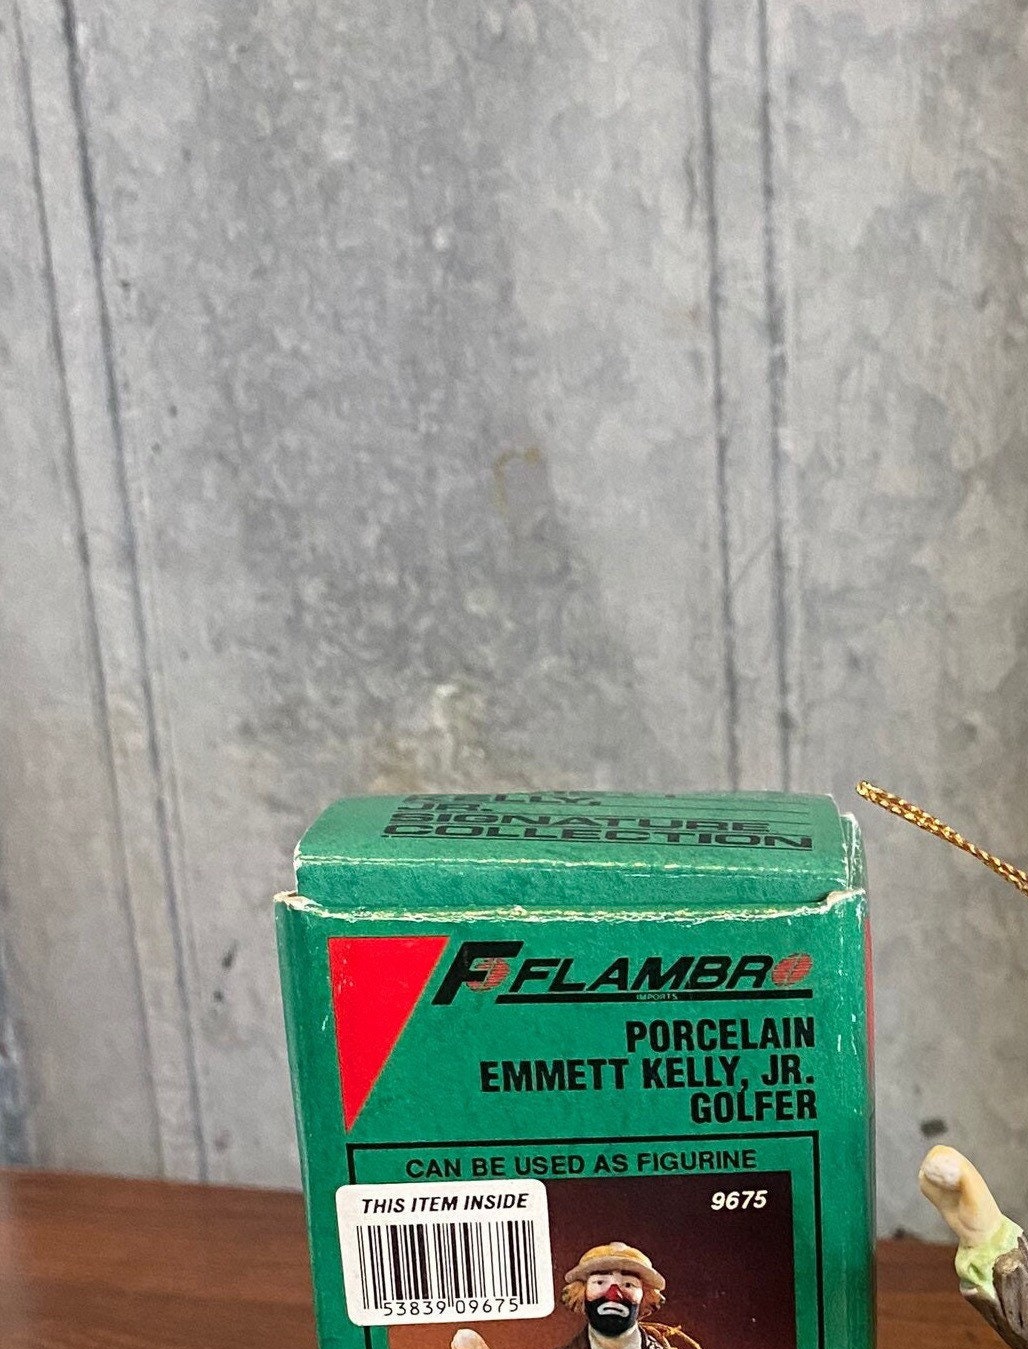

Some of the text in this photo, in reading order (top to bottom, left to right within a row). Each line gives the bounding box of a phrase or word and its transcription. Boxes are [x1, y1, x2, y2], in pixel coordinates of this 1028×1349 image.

[389, 812, 770, 833] SIGNATURE
[383, 824, 813, 848] COLLECTION
[625, 1016, 816, 1053] PORCELAIN
[479, 1053, 815, 1093] EMMETT KELLY, JR.
[690, 1089, 818, 1125] GOLFER
[405, 1148, 758, 1179] CAN BE USED AS FIGURINE
[362, 1192, 530, 1214] THIS ITEM INSIDE
[710, 1189, 769, 1211] 9675
[383, 1297, 519, 1317] 53839 09675
